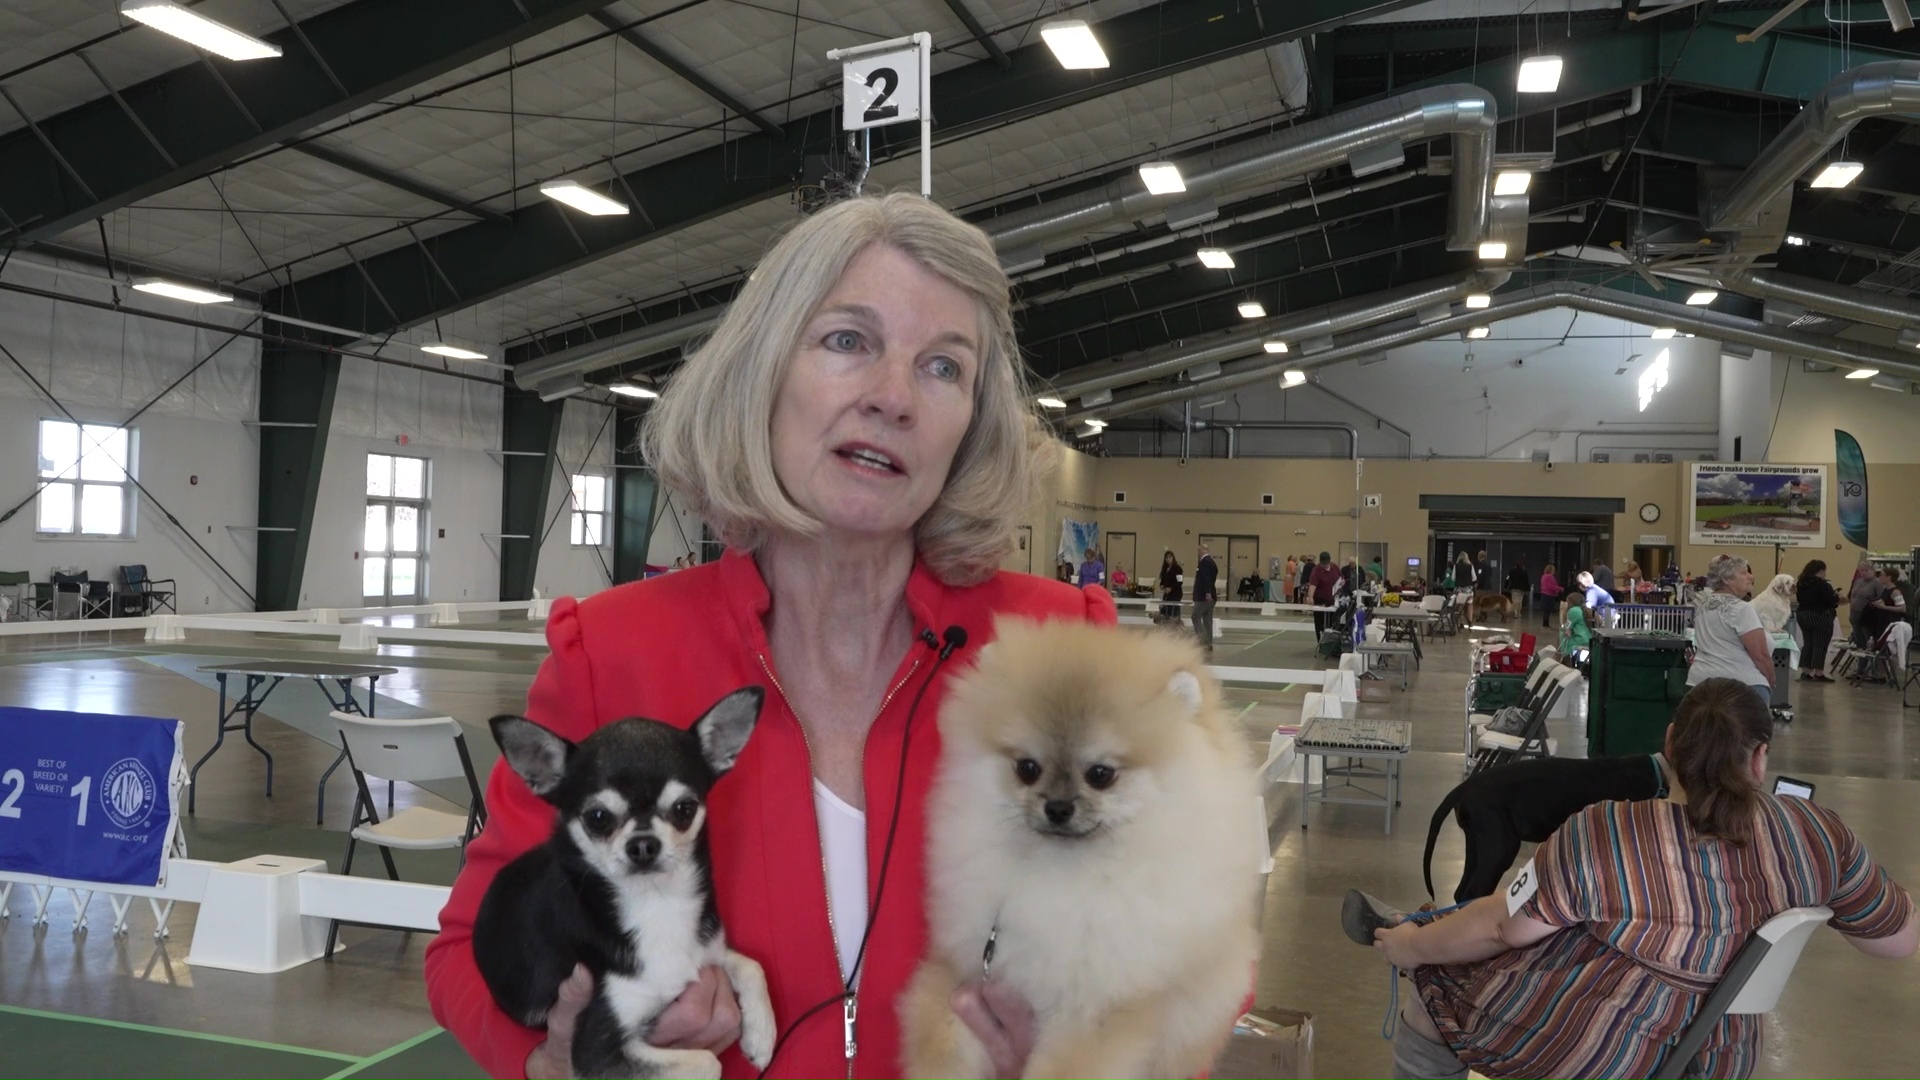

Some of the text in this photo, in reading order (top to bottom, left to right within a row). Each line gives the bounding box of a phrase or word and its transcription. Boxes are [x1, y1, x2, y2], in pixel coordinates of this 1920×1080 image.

[864, 67, 898, 122] 2
[1760, 466, 1800, 474] Fairgrounds
[33, 770, 69, 782] BREED OR
[37, 758, 67, 769] BEST OF
[103, 762, 129, 797] AMERICAN
[143, 780, 152, 801] CLUB
[0, 768, 25, 819] 2
[35, 783, 65, 794] VARIETY
[70, 776, 92, 827] 1
[113, 773, 142, 815] AKC
